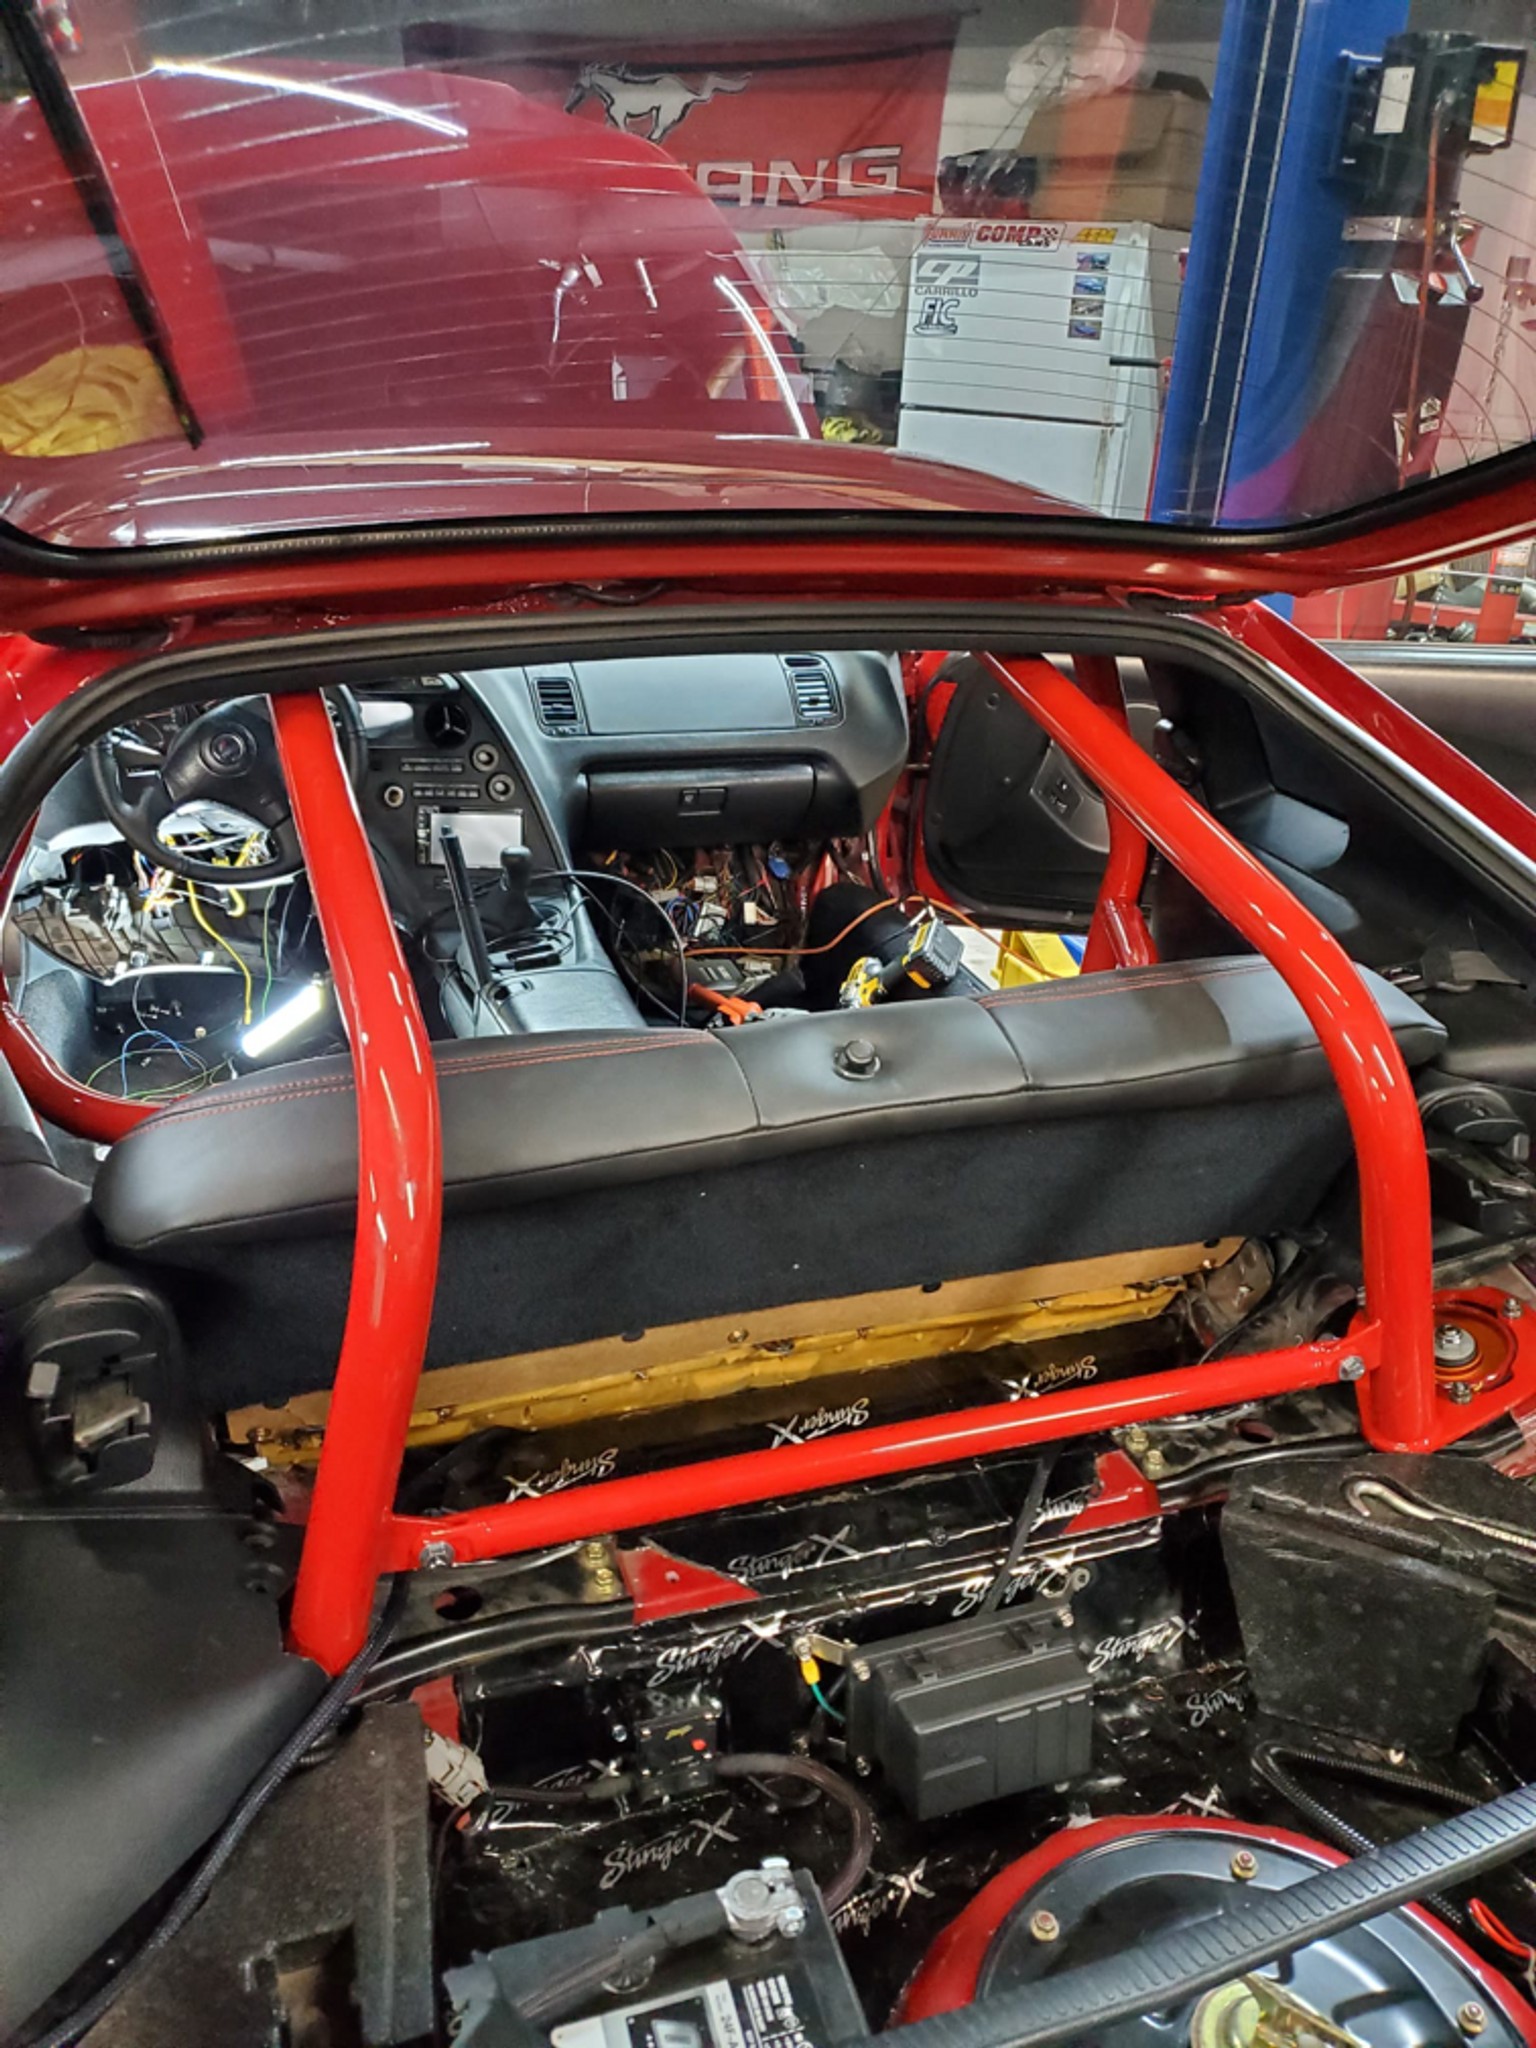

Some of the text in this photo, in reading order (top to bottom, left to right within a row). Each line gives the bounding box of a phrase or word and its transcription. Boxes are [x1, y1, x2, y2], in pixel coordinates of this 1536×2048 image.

[690, 145, 902, 207] ANG
[976, 225, 1041, 243] COMP
[914, 285, 979, 298] CARRILLO
[920, 297, 960, 326] FIC
